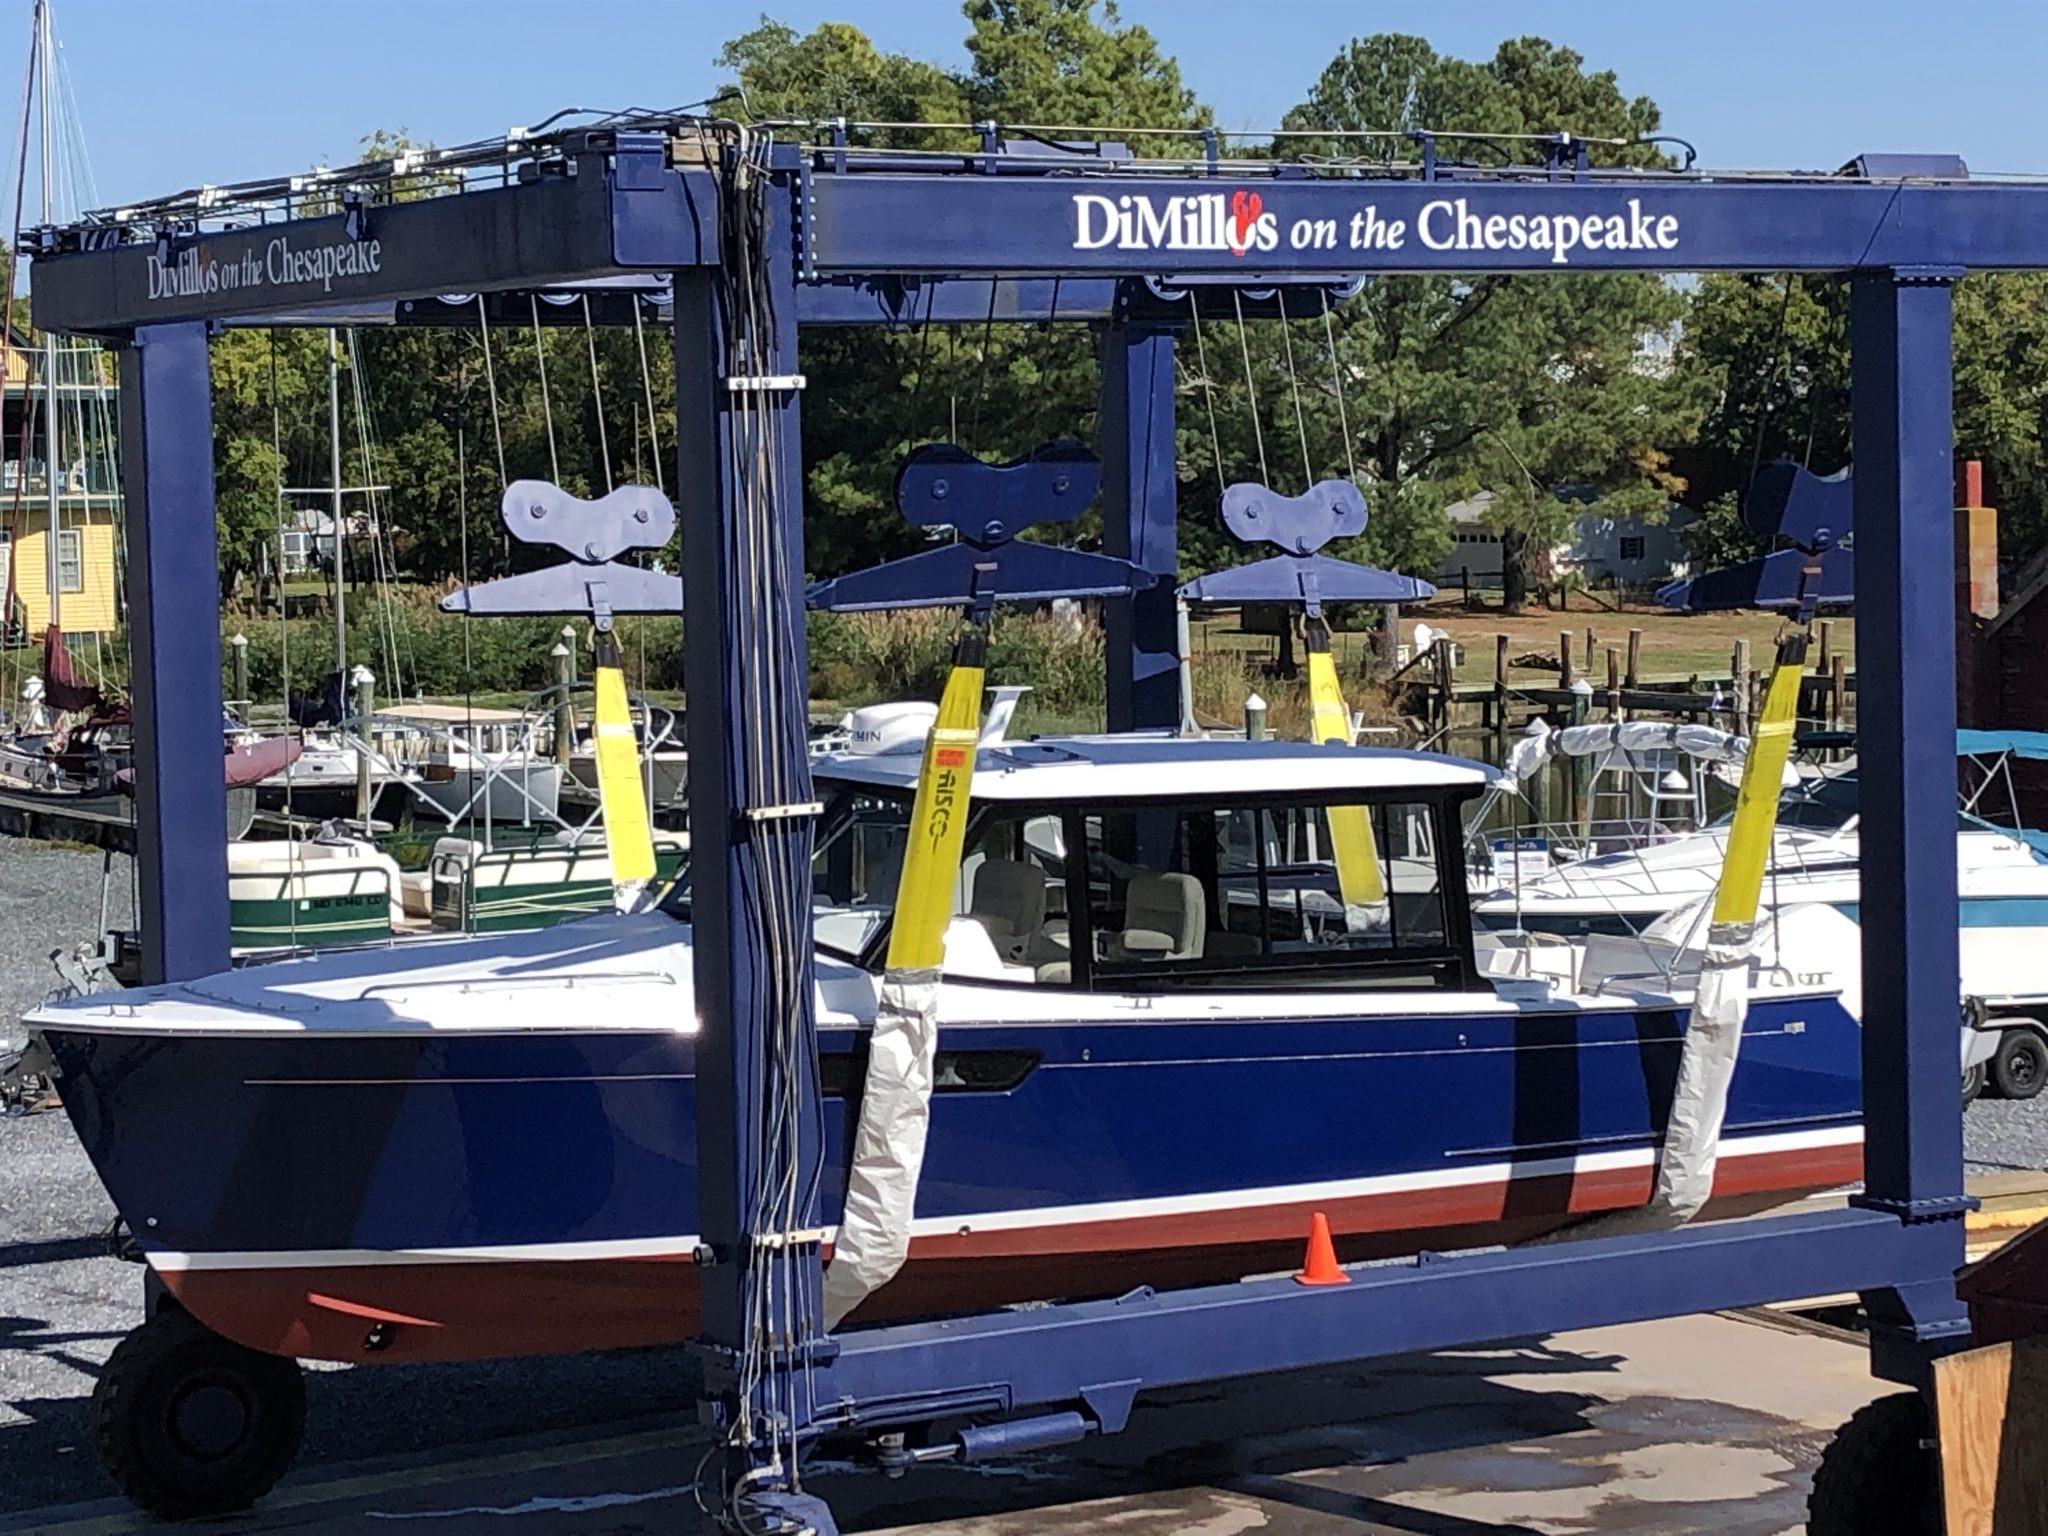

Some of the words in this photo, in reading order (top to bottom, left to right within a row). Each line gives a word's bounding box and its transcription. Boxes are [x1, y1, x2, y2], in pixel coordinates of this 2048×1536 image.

[1290, 219, 1338, 250] on
[1350, 205, 1405, 250] the
[1418, 198, 1679, 263] Chesapeake
[221, 263, 239, 290] on
[242, 248, 262, 287] the
[267, 236, 381, 292] Chesapeake
